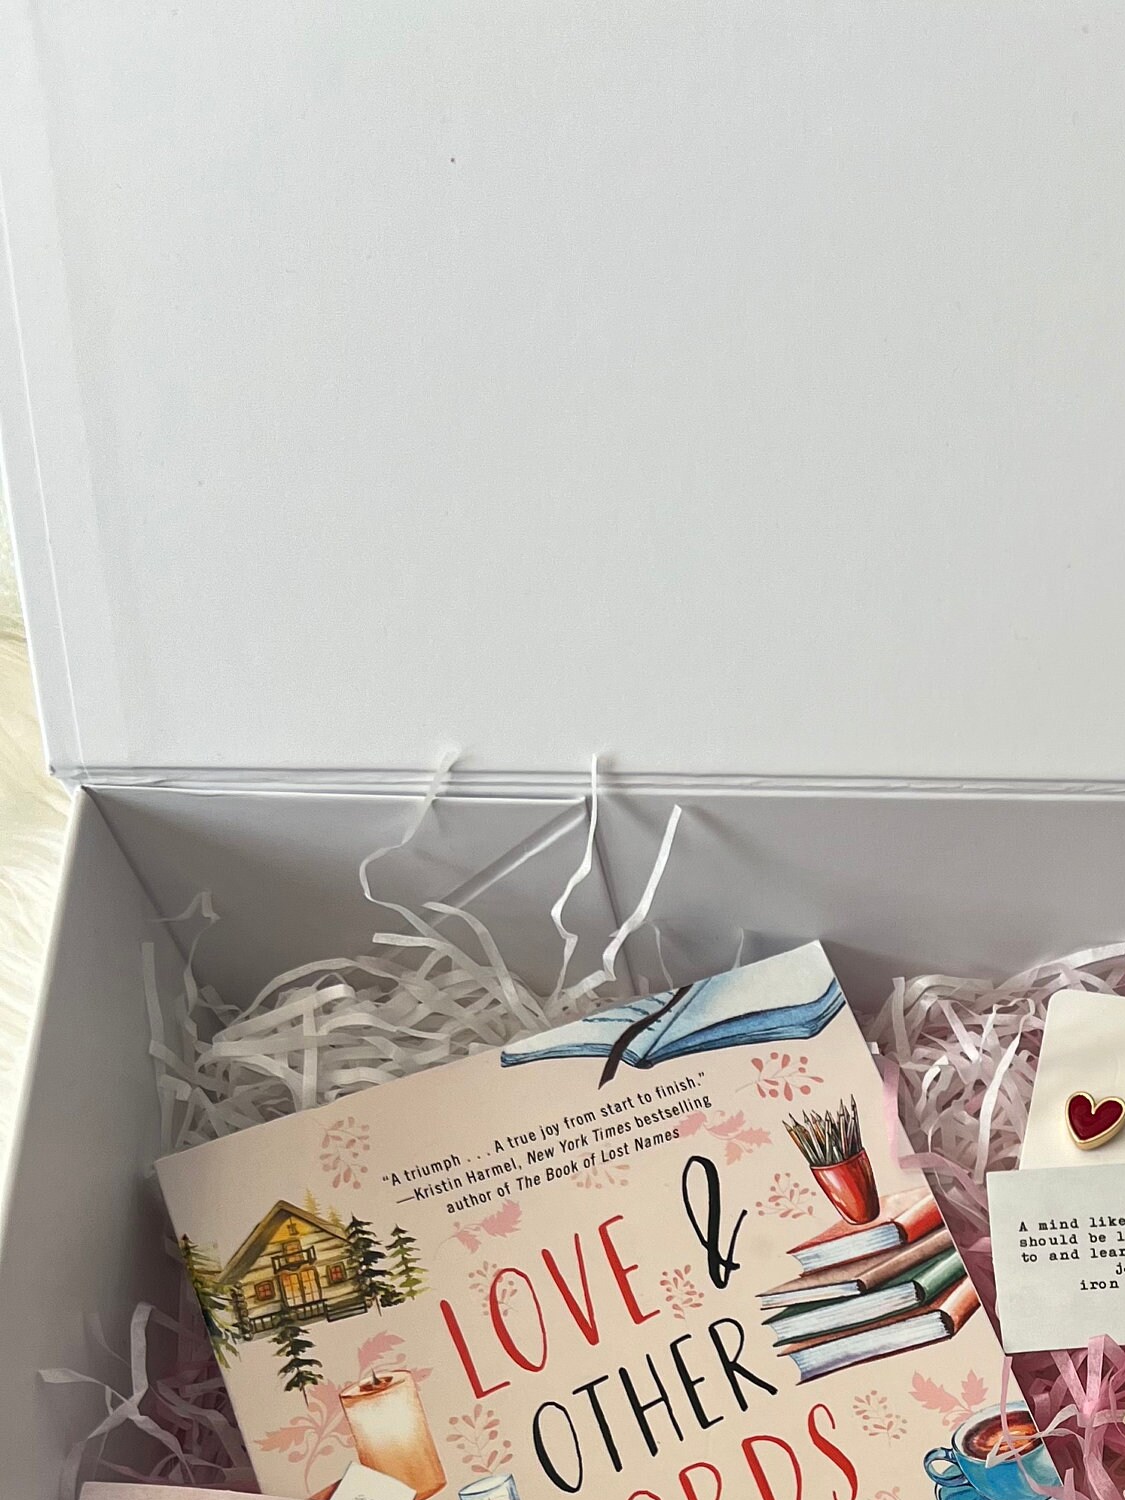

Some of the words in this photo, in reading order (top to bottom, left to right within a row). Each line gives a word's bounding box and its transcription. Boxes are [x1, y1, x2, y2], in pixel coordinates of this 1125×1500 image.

[404, 1154, 461, 1184] triumph
[494, 1140, 505, 1154] A
[506, 1131, 538, 1150] true
[540, 1123, 560, 1141] joy
[563, 1111, 597, 1130] from
[600, 1097, 636, 1118] start
[638, 1091, 653, 1106] to
[446, 1189, 493, 1214] author
[496, 1182, 513, 1198] of
[516, 1173, 543, 1192] The
[546, 1161, 579, 1182] Book
[582, 1153, 597, 1170] of
[600, 1144, 631, 1164] Lost
[634, 1128, 681, 1152] Names
[466, 1158, 523, 1184] Harmel,
[527, 1147, 556, 1165] New
[559, 1136, 590, 1155] York
[592, 1122, 633, 1143] Times
[634, 1094, 713, 1129] bestselling
[1019, 1220, 1029, 1233] A
[1038, 1217, 1079, 1231] mind
[1089, 1214, 1125, 1228] like
[1019, 1233, 1078, 1248] should
[1089, 1230, 1107, 1244] be
[1021, 1249, 1038, 1263] to
[1048, 1247, 1079, 1261] and
[439, 1214, 661, 1400] LOVE
[681, 1154, 748, 1290] &
[1080, 1277, 1119, 1291] iron
[531, 1316, 779, 1494] OTHER
